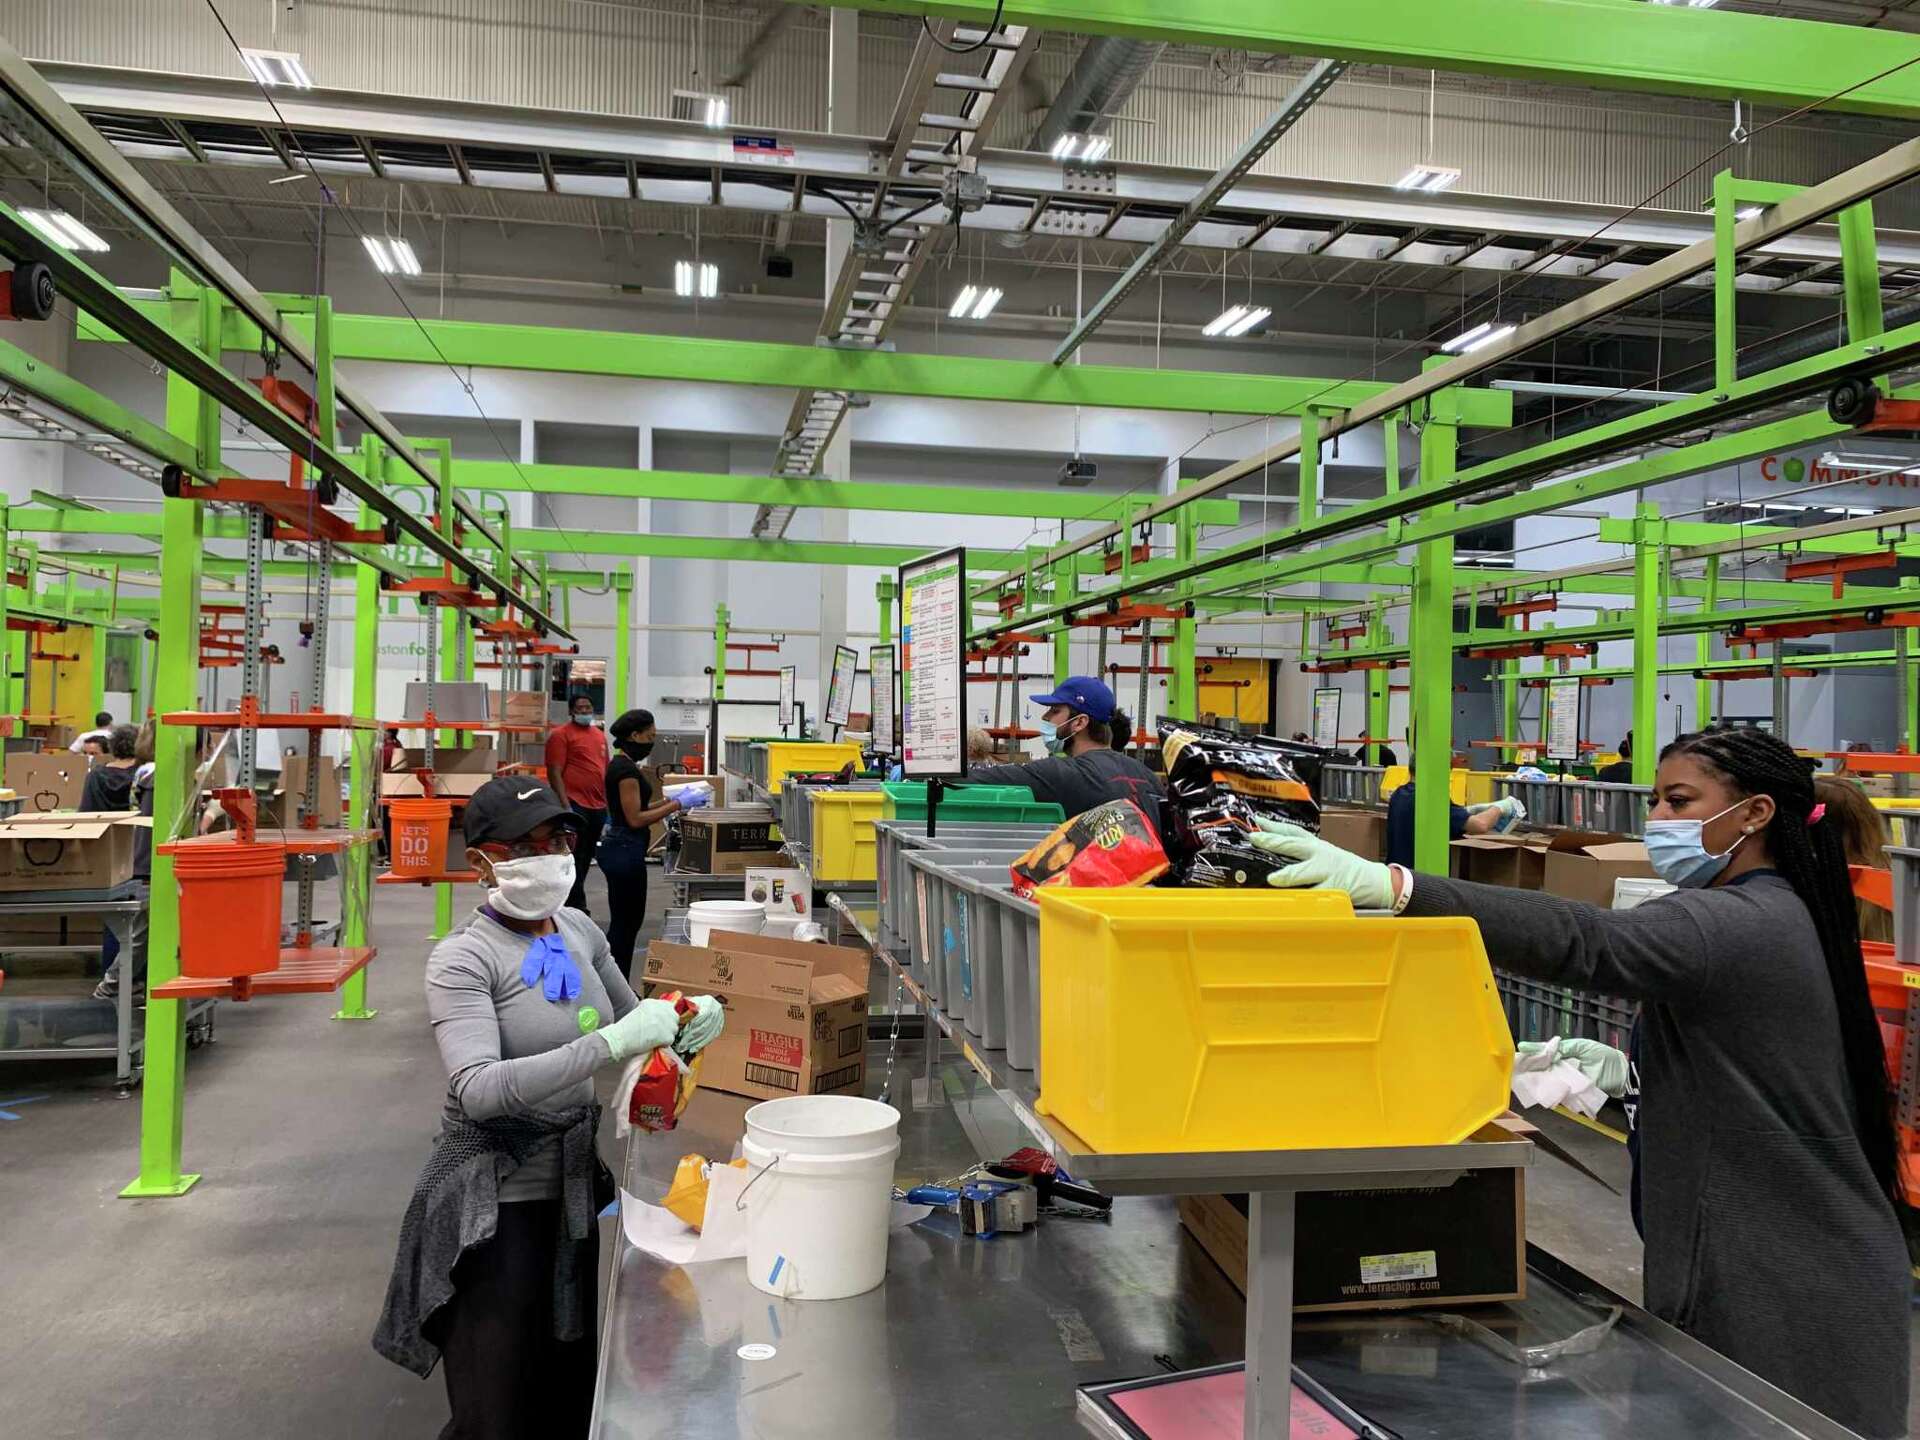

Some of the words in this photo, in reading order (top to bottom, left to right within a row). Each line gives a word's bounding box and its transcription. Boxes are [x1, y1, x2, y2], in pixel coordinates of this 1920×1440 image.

[400, 825, 429, 836] LET'S
[731, 828, 768, 841] TERR
[400, 836, 429, 854] DO
[754, 1031, 800, 1050] FRAGILE
[764, 1046, 788, 1056] HANDLE
[759, 1052, 775, 1061] WITH
[775, 1055, 791, 1064] CARE
[1341, 1280, 1440, 1296] www.terrachips.com
